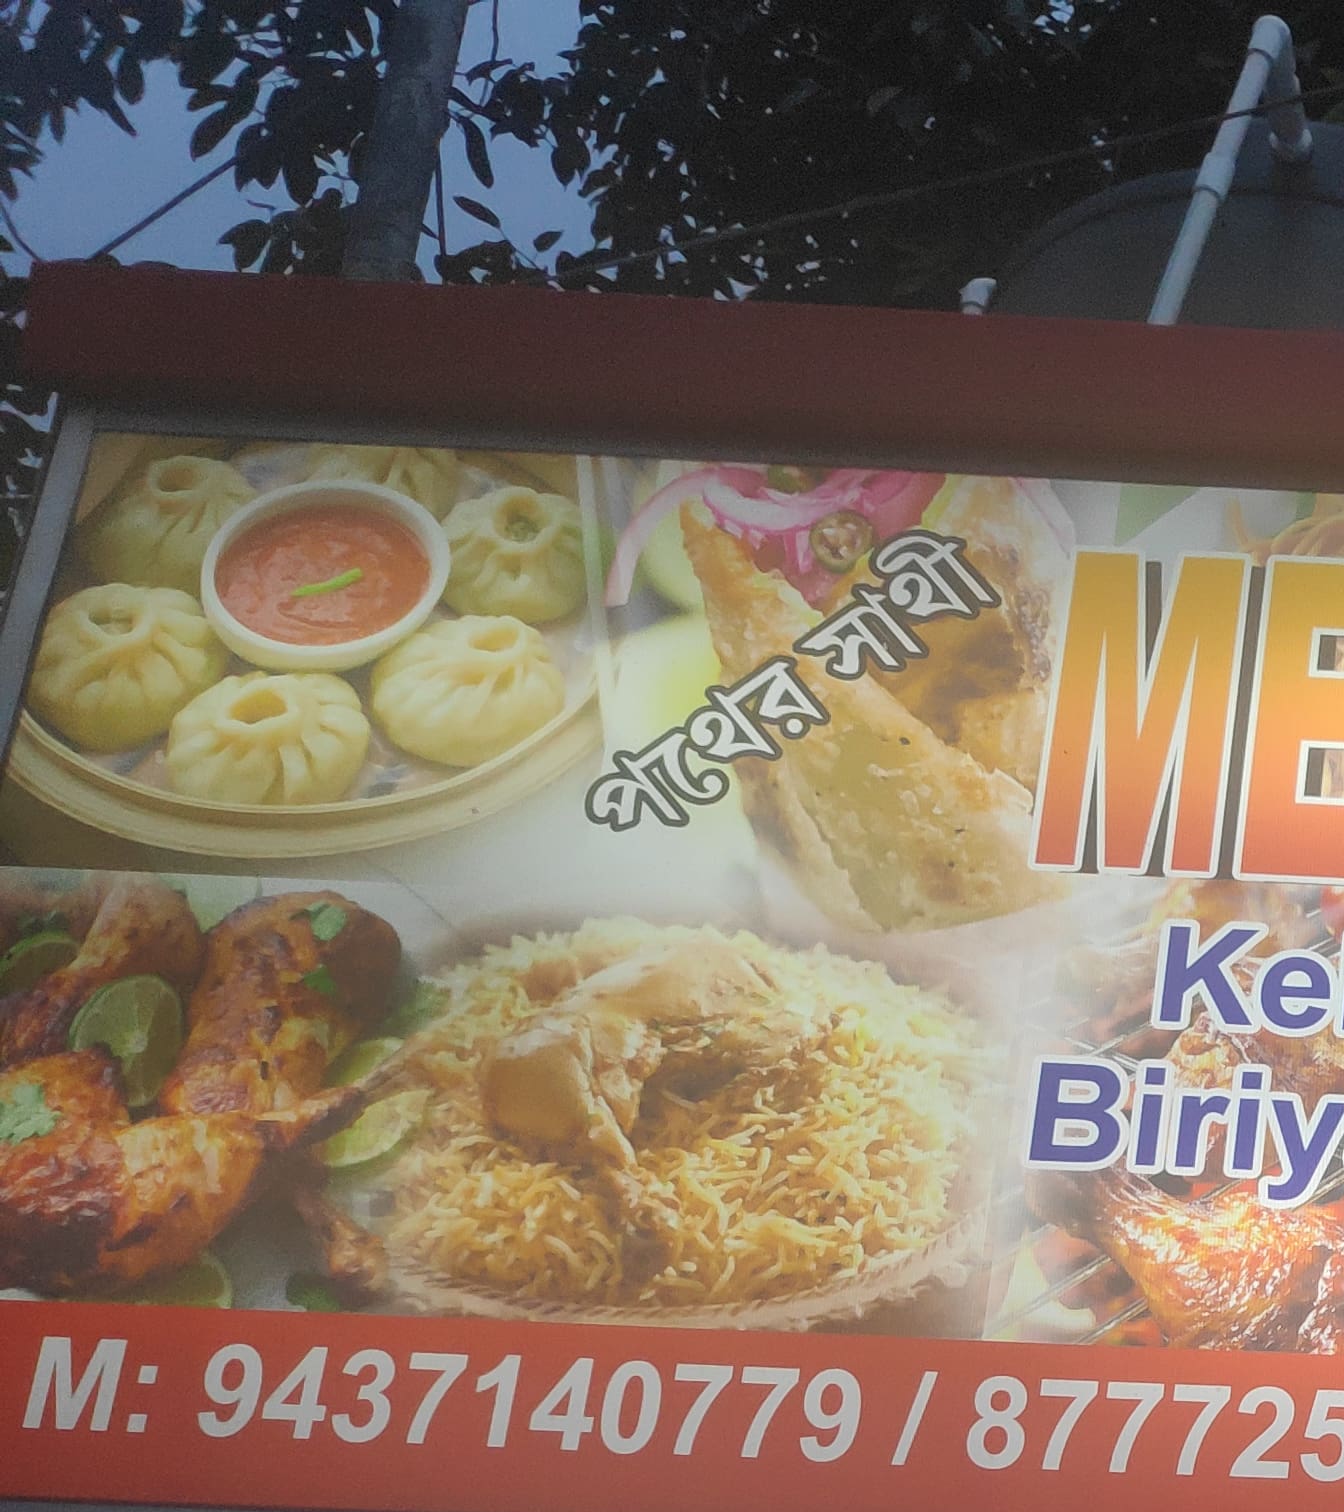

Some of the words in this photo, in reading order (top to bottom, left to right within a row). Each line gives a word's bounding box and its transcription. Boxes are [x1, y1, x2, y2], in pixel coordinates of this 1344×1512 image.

[585, 656, 830, 831] পথের
[793, 530, 1001, 679] সাথী
[22, 1336, 158, 1434] M:
[197, 1343, 863, 1463] 9437140779
[891, 1371, 938, 1467] /
